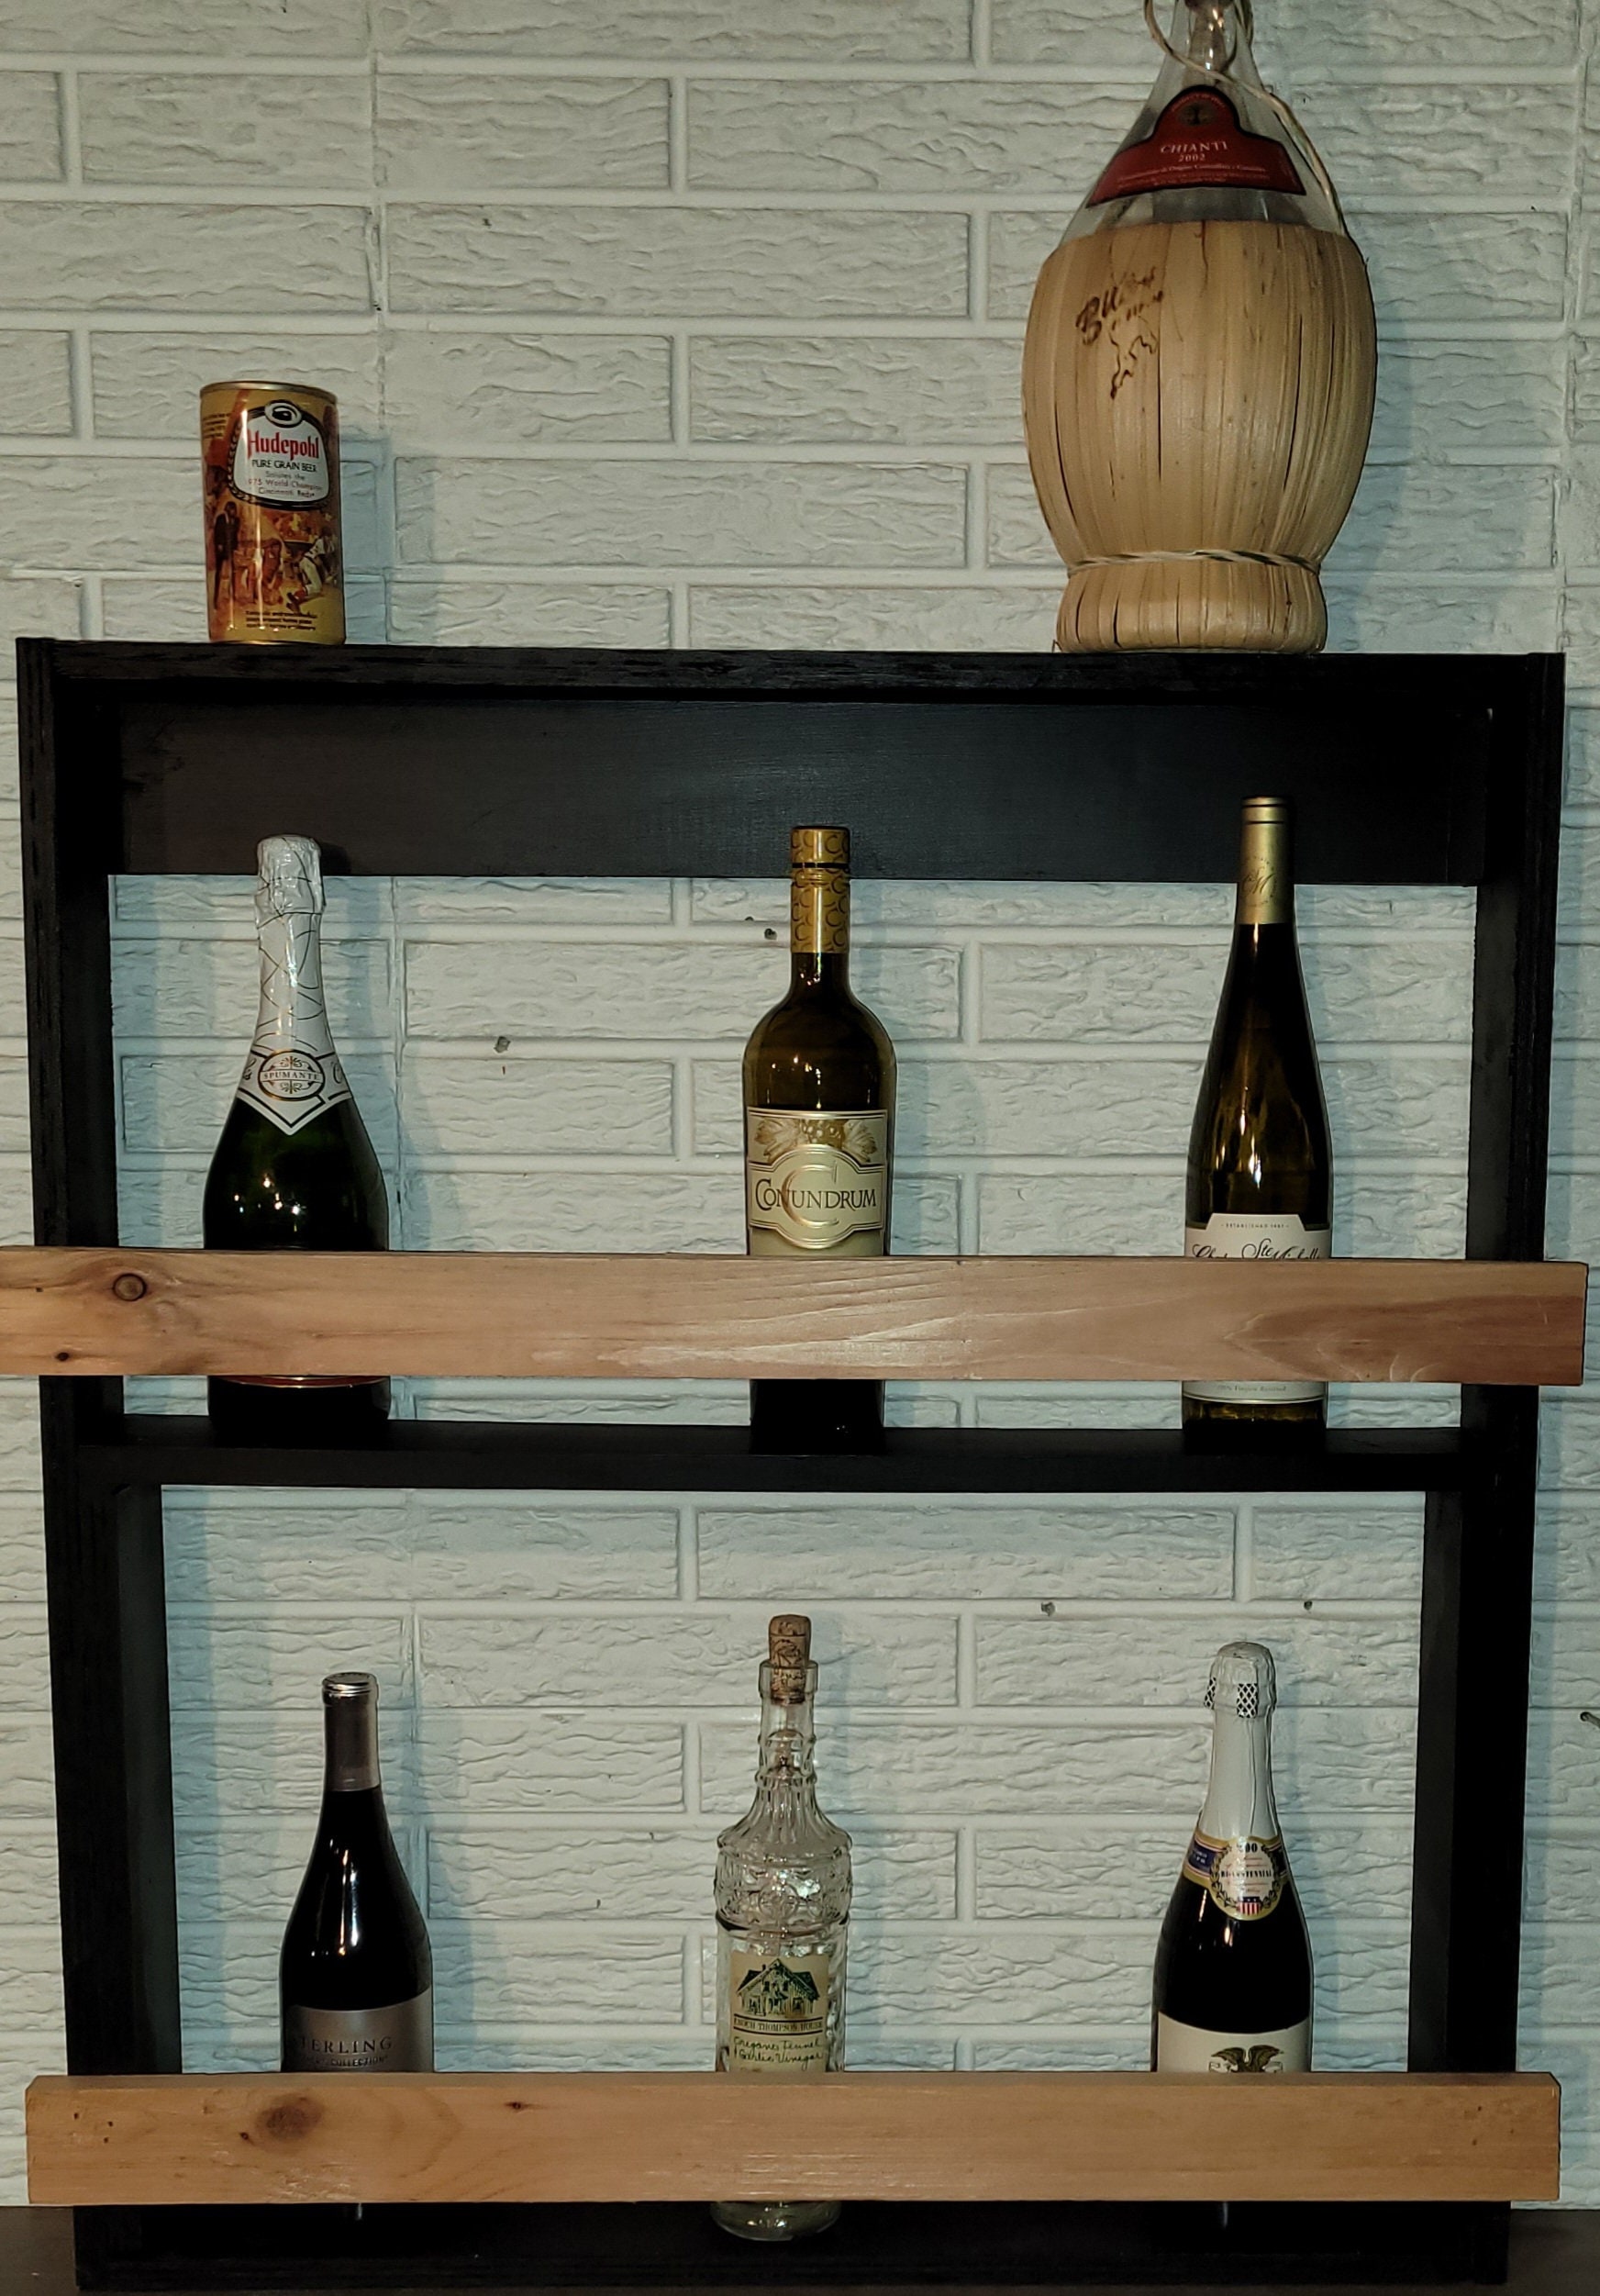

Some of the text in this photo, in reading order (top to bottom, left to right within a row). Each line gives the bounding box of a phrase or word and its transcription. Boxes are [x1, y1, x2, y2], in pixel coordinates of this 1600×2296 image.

[1160, 140, 1228, 154] CHIANTI
[1178, 154, 1206, 162] 2002
[247, 429, 319, 461] Hudepohl
[251, 459, 317, 473] PURE GRAIN BEER
[263, 1071, 322, 1081] SPUMANTE
[298, 2036, 393, 2055] TERLING
